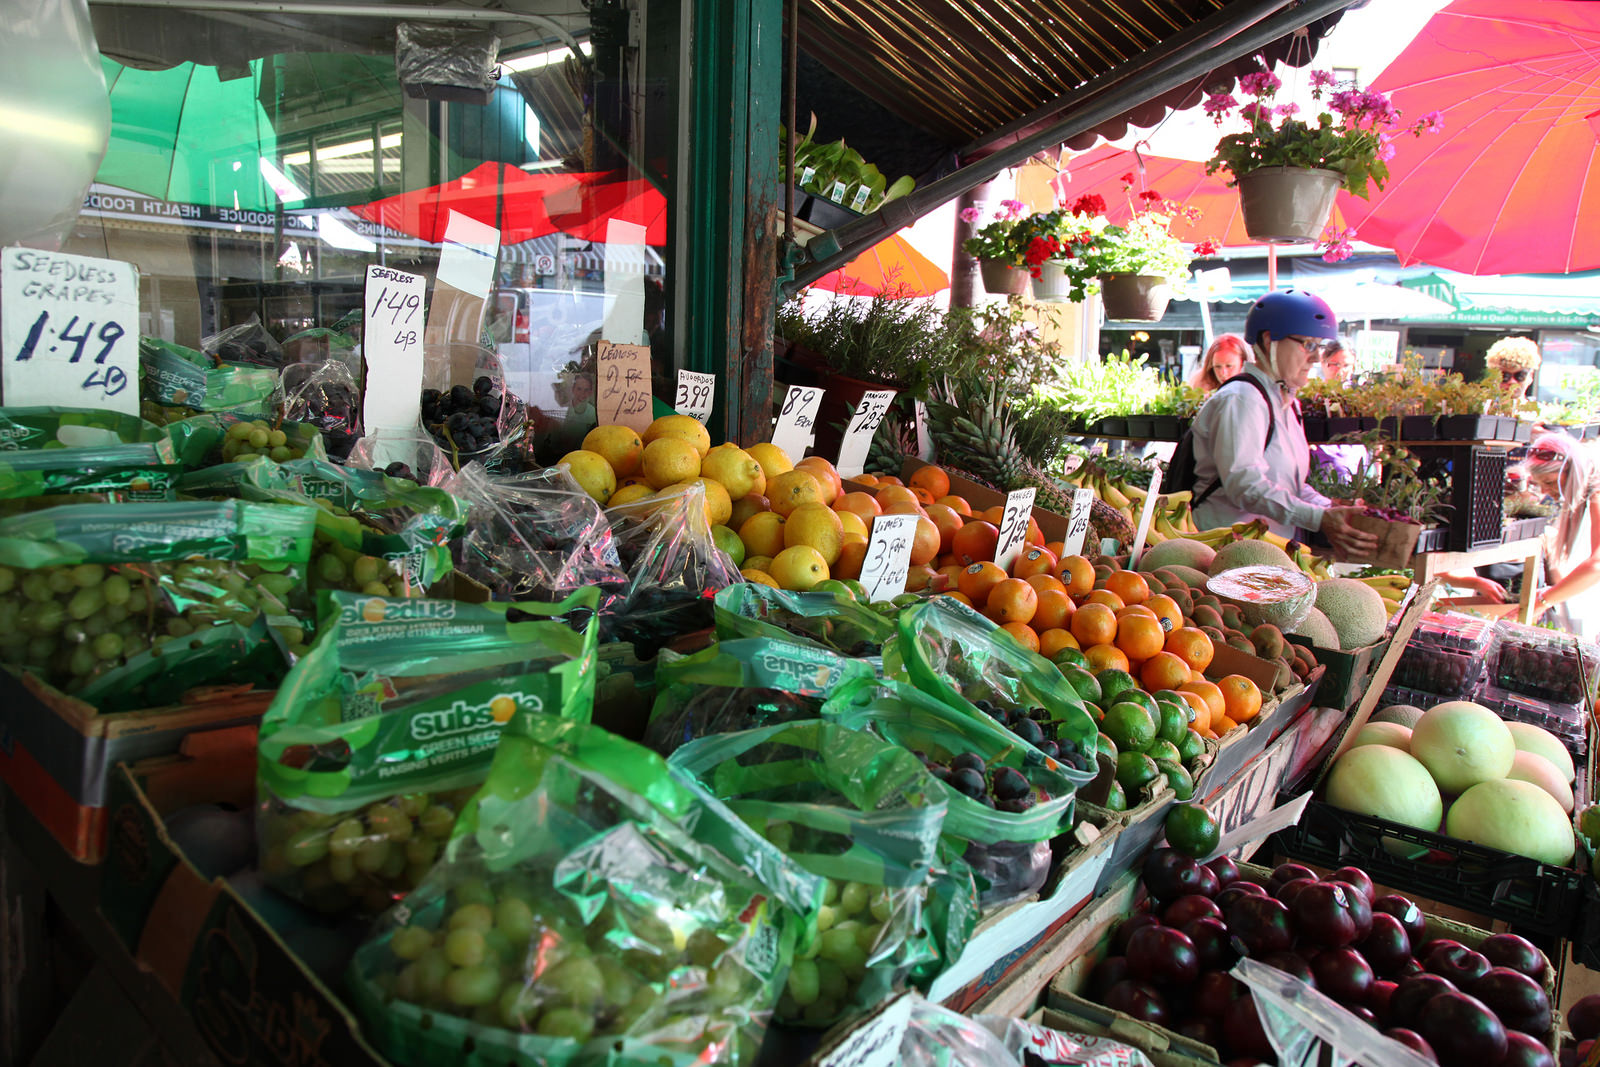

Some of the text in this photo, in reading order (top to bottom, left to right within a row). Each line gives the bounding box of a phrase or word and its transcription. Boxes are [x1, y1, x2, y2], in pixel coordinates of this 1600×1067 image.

[13, 251, 117, 285] SEEDLESS
[371, 266, 415, 284] SEEDLESS
[22, 279, 115, 305] GRAPES
[603, 364, 620, 400] 2
[676, 384, 710, 409] 3.99
[613, 389, 650, 422] 1.25
[782, 387, 816, 416] 89
[855, 401, 870, 416] 3
[1001, 506, 1018, 535] 3
[1071, 502, 1082, 520] 3
[865, 539, 887, 573] 3
